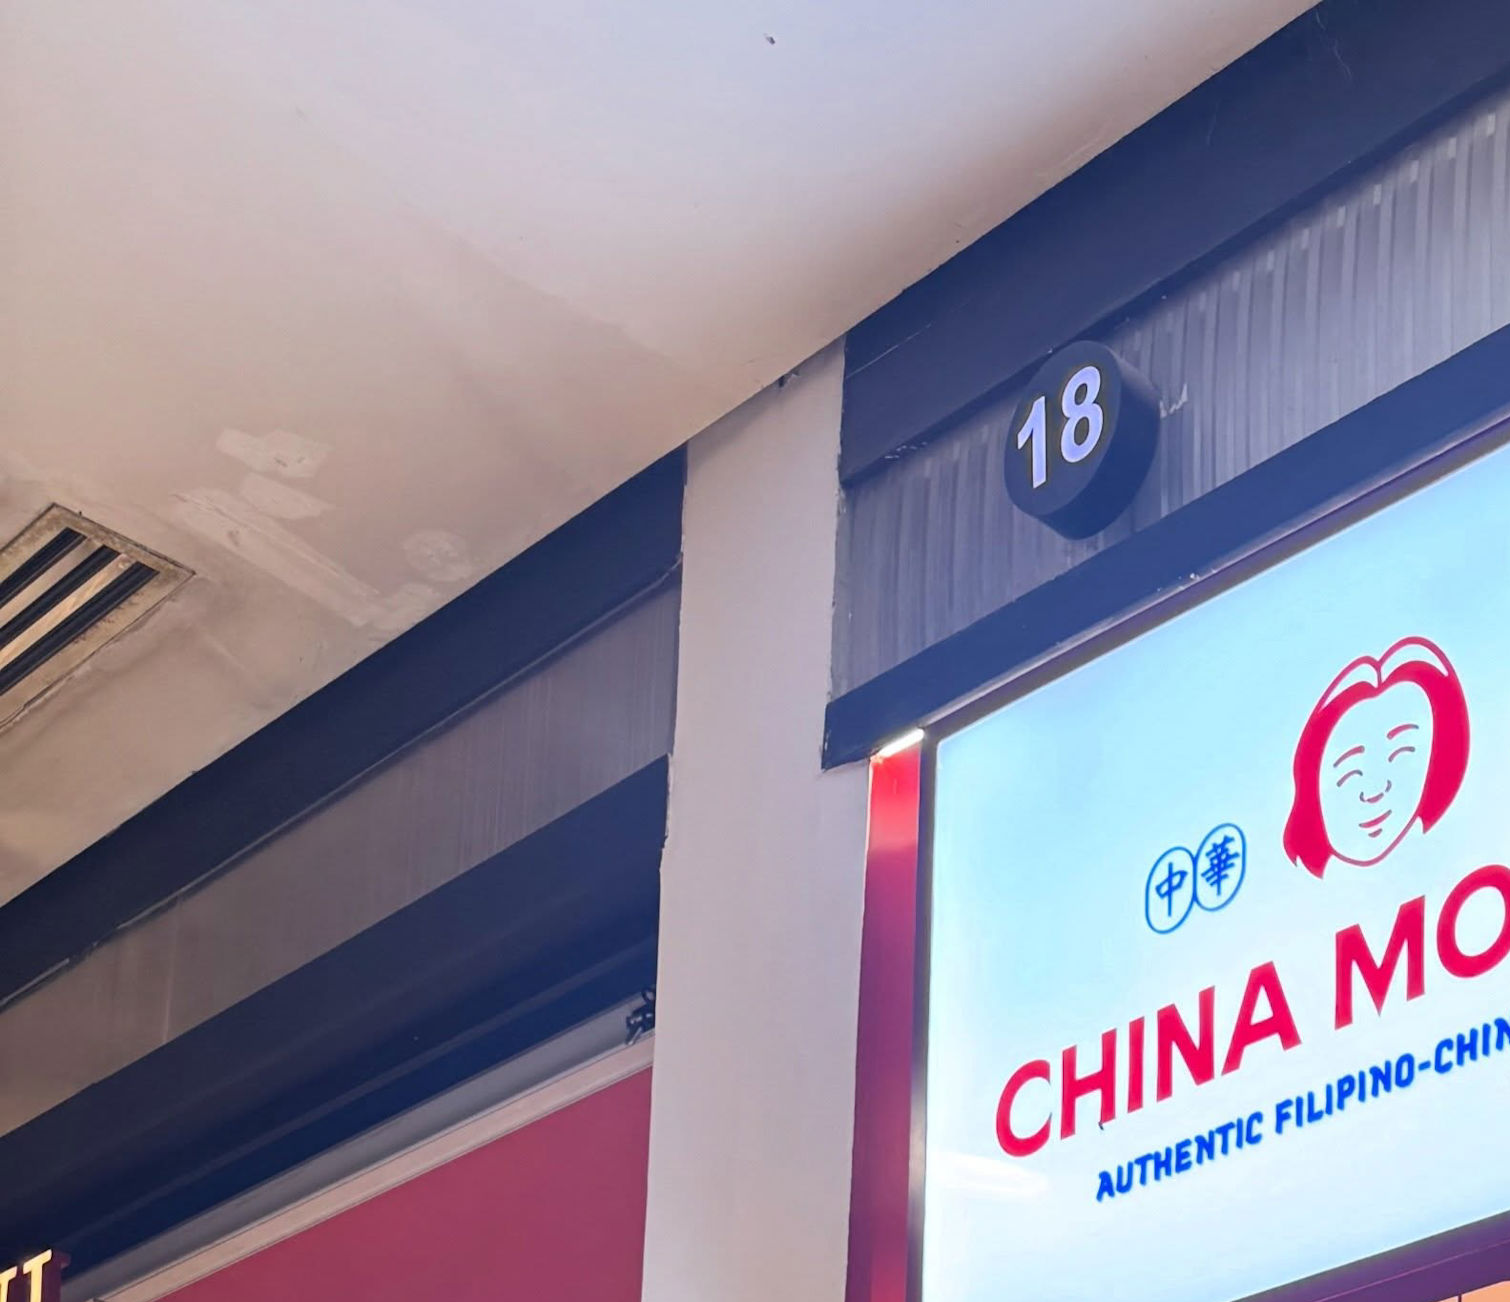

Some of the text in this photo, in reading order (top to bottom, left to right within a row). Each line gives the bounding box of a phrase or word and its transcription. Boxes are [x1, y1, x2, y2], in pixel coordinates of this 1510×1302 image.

[1017, 365, 1104, 489] 18
[1152, 834, 1241, 920] 中華
[996, 960, 1302, 1158] CHINA
[1096, 1109, 1264, 1203] AUTHENTIC
